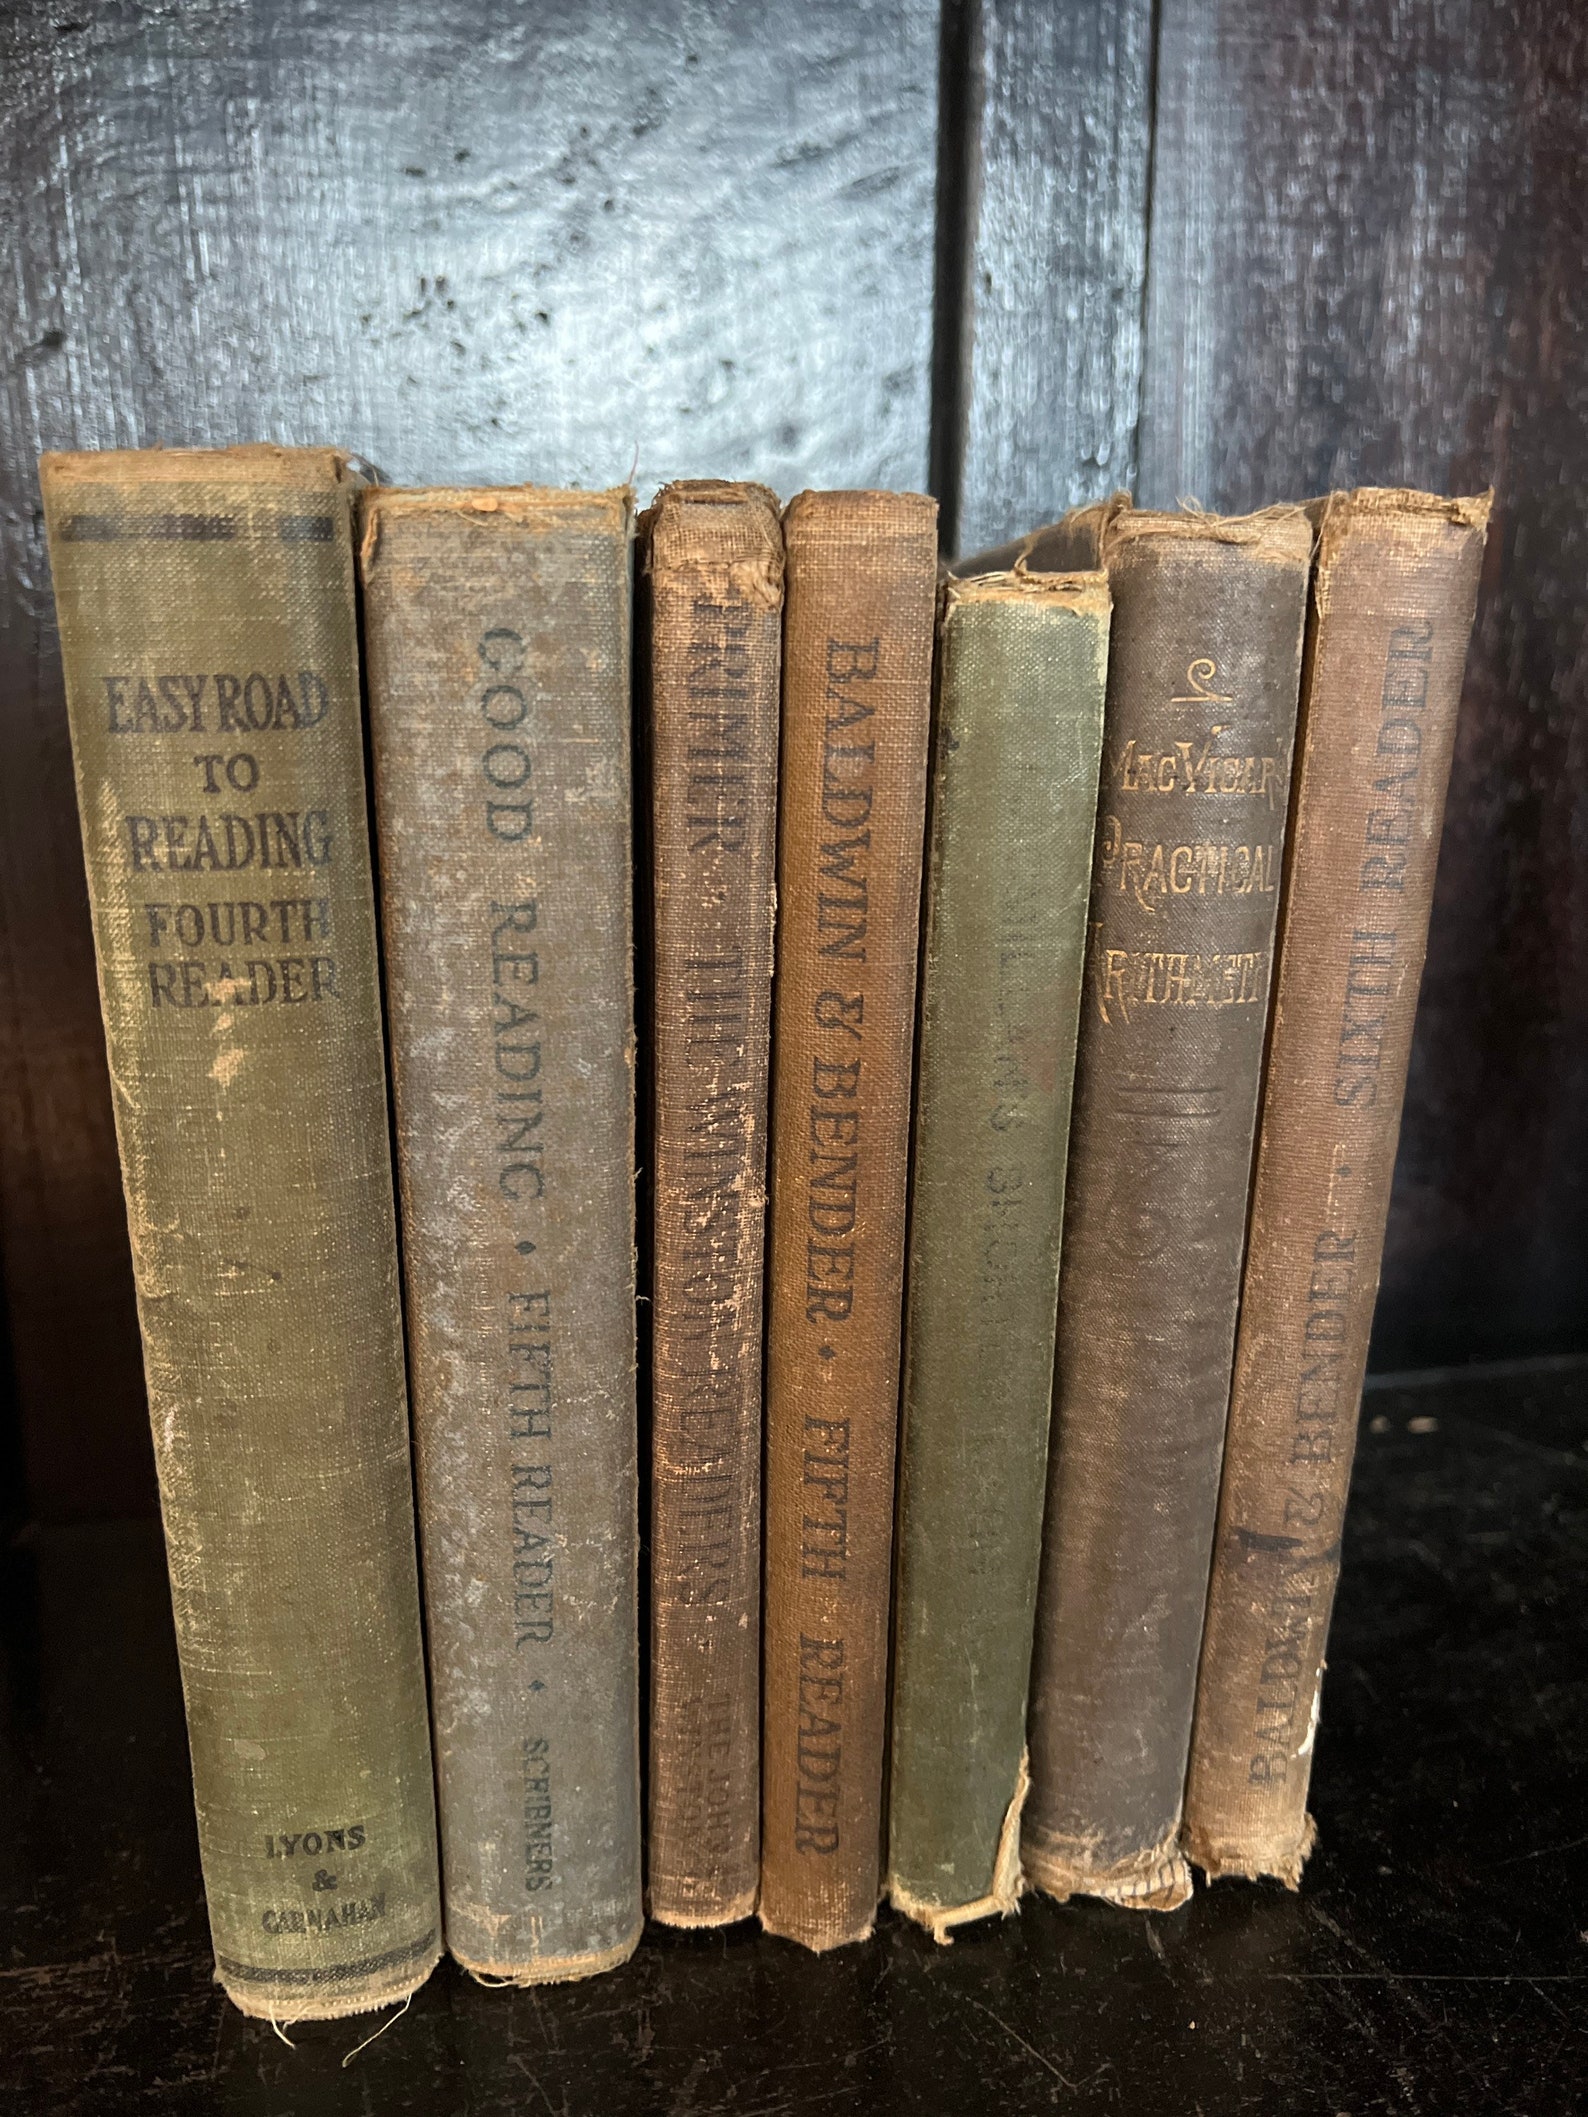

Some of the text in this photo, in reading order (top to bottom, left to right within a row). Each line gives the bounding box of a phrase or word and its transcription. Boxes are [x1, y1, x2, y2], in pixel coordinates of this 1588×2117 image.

[103, 671, 329, 734] EASY ROAD
[194, 753, 260, 793] TO
[1360, 620, 1433, 892] READER
[125, 809, 334, 873] READING
[144, 899, 331, 948] FOURTH
[148, 956, 343, 1009] READER
[491, 900, 545, 1201] READING
[1334, 928, 1397, 1109] SIXTH
[795, 637, 879, 1856] BALDWIN & BENDER FIFTH READER
[508, 1292, 552, 1440] FIFTH
[1288, 1229, 1357, 1465] BENDER
[1283, 1485, 1324, 1527] &
[510, 1464, 555, 1650] READER
[264, 1825, 367, 1859] LYONS
[312, 1869, 338, 1892] &
